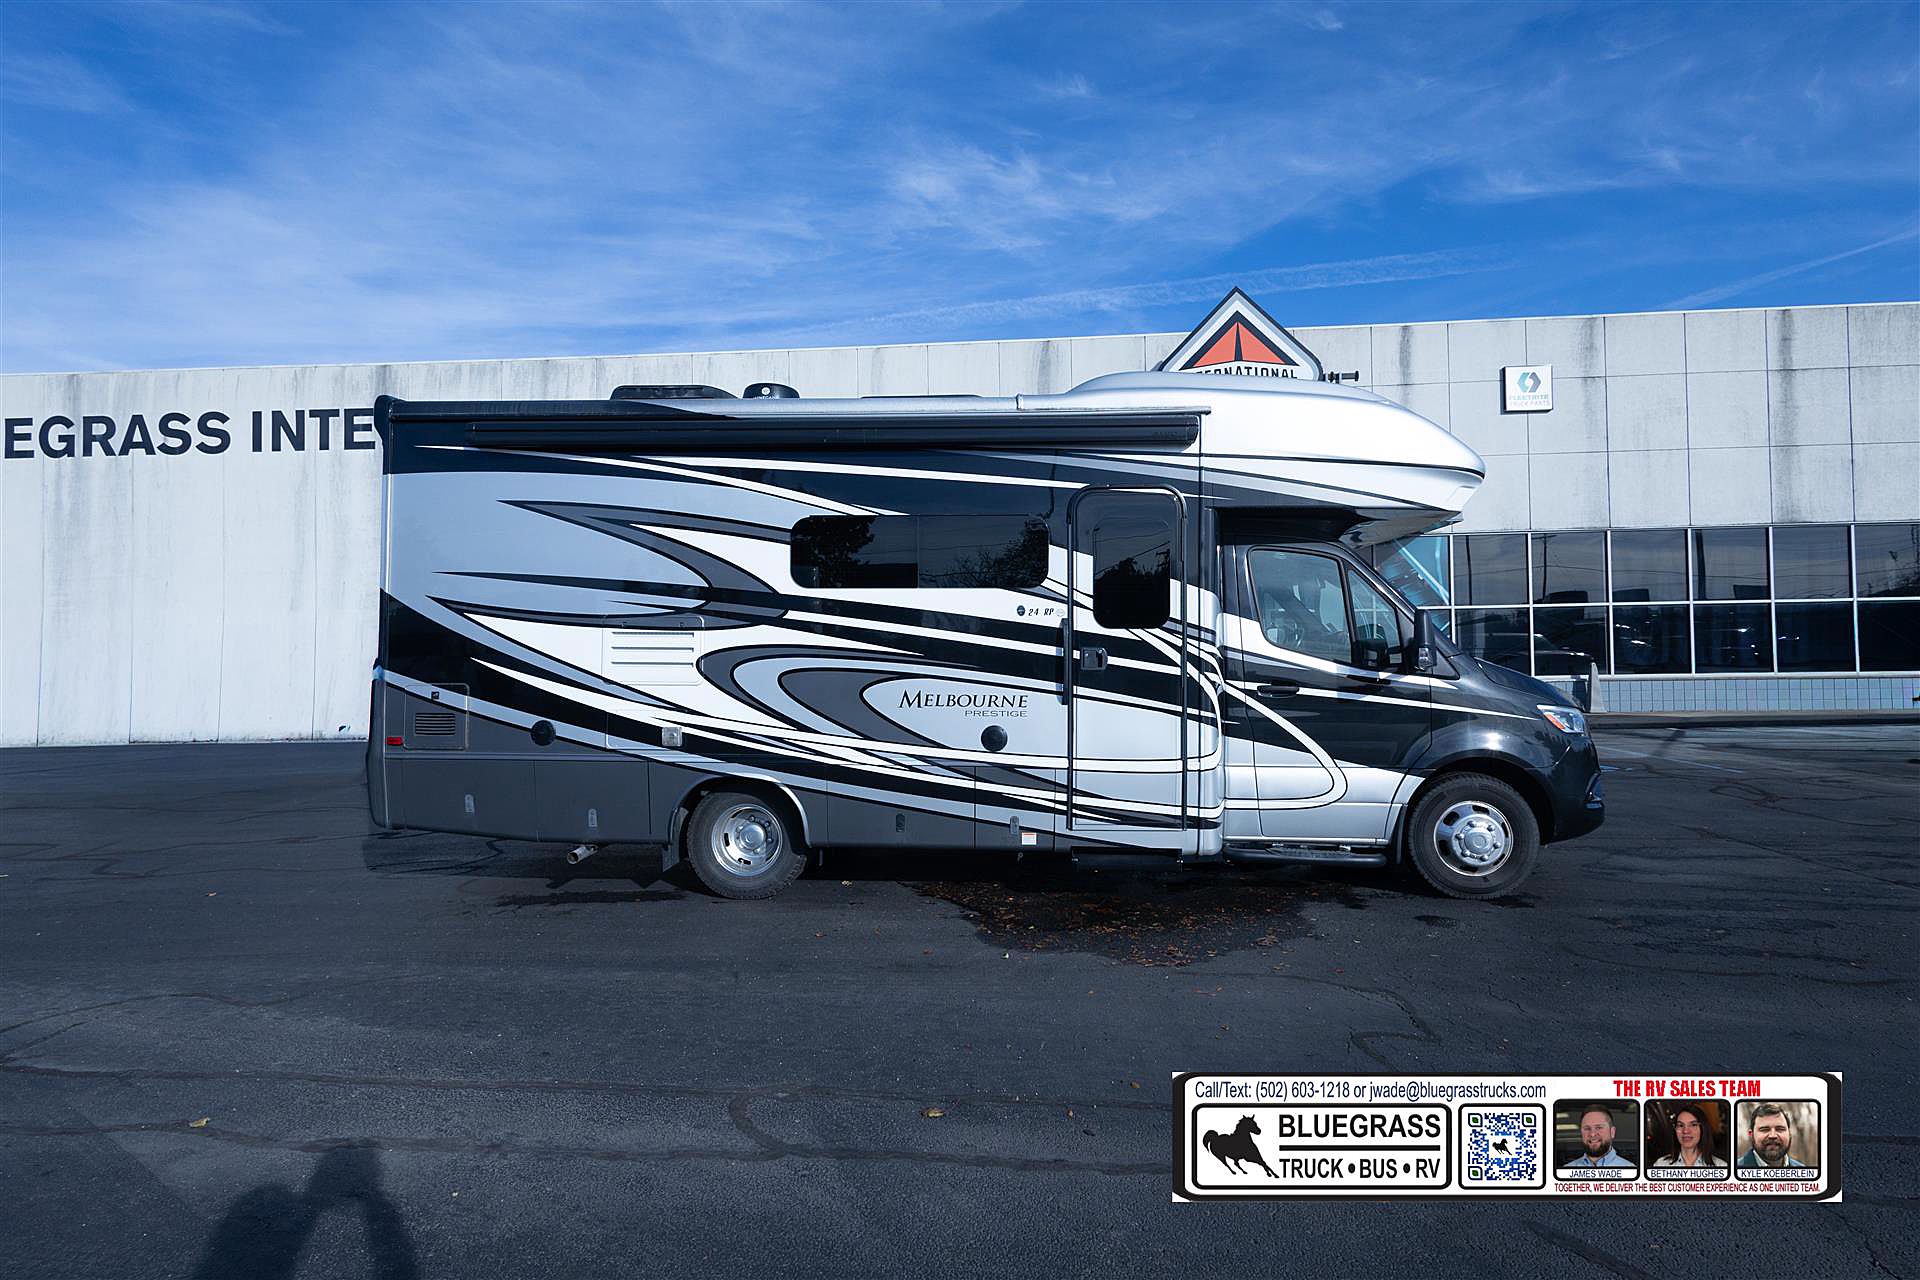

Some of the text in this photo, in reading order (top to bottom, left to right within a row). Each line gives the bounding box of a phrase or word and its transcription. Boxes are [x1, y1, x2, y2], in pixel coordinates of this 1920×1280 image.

[4, 408, 376, 459] EGRASS INTE
[1028, 608, 1039, 616] 24
[965, 710, 1028, 718] PRESTIGE
